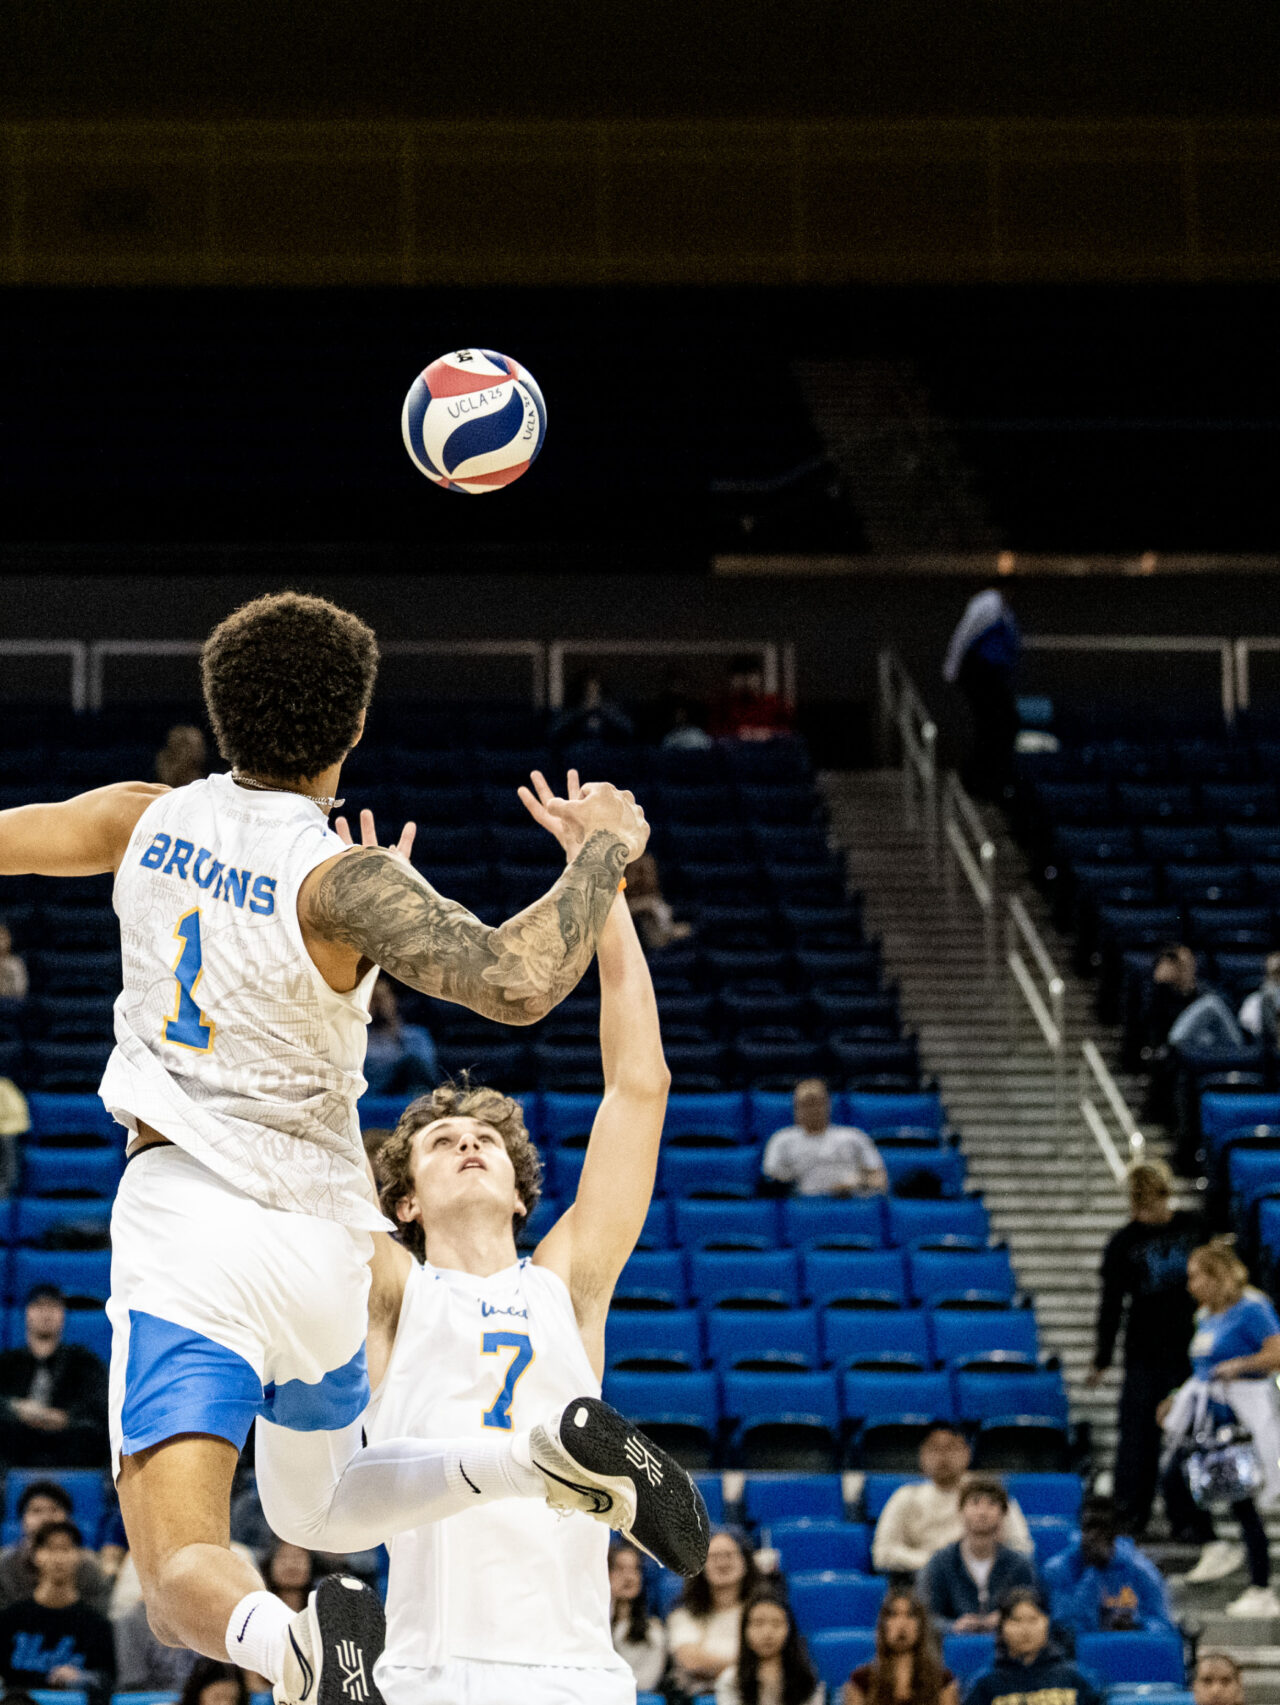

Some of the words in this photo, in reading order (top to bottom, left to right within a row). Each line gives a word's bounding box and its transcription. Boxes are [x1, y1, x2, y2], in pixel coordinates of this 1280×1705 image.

[447, 393, 489, 419] UCLA
[487, 387, 503, 400] 25
[522, 409, 536, 440] UCLA
[138, 832, 278, 917] BRUINS
[161, 905, 216, 1055] 1
[480, 1328, 536, 1432] 7
